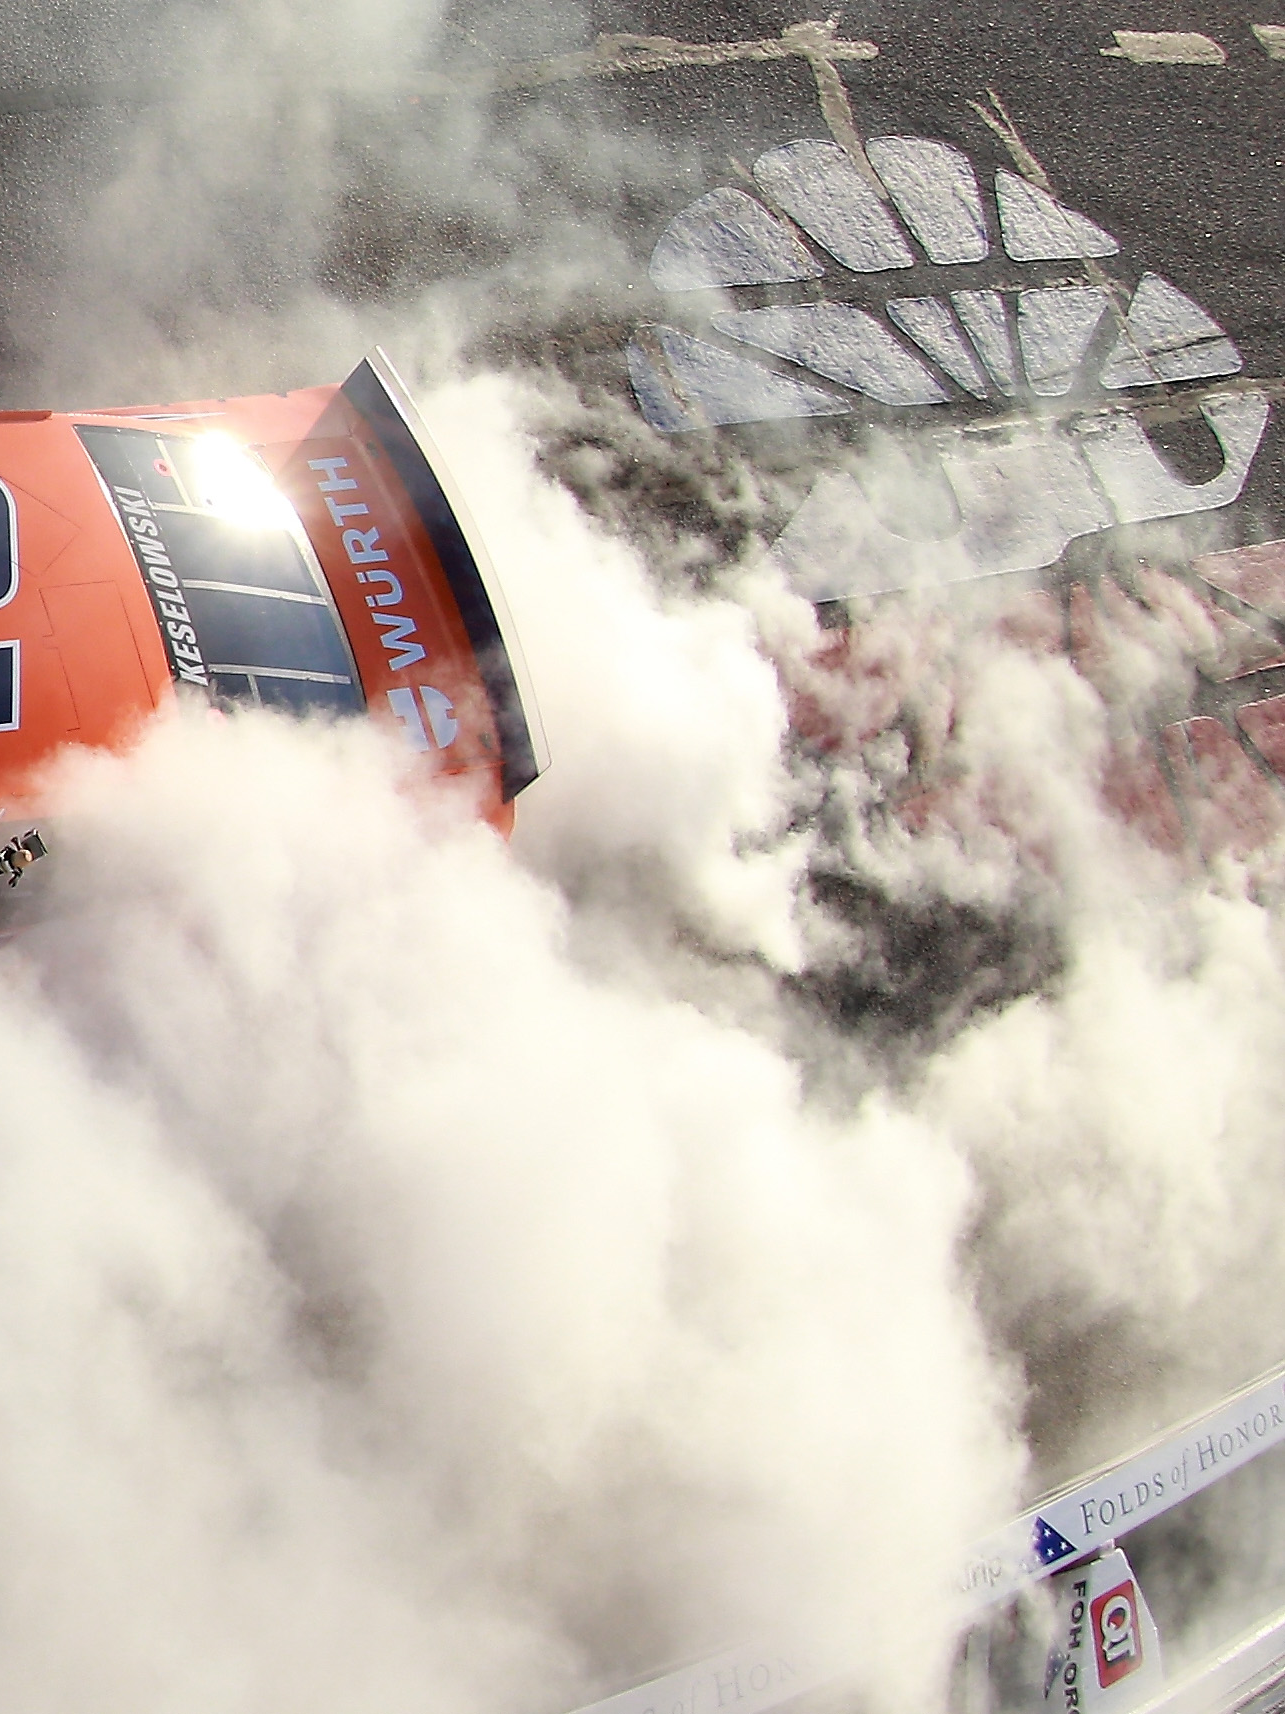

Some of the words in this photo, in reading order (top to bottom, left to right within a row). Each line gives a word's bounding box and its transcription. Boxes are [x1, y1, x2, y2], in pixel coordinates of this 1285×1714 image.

[114, 486, 209, 686] KESELOWSKI
[1080, 1473, 1164, 1536] FOLDS
[1171, 1448, 1189, 1491] of
[1196, 1404, 1284, 1472] HONOR
[1063, 1581, 1087, 1714] FOH.OR
